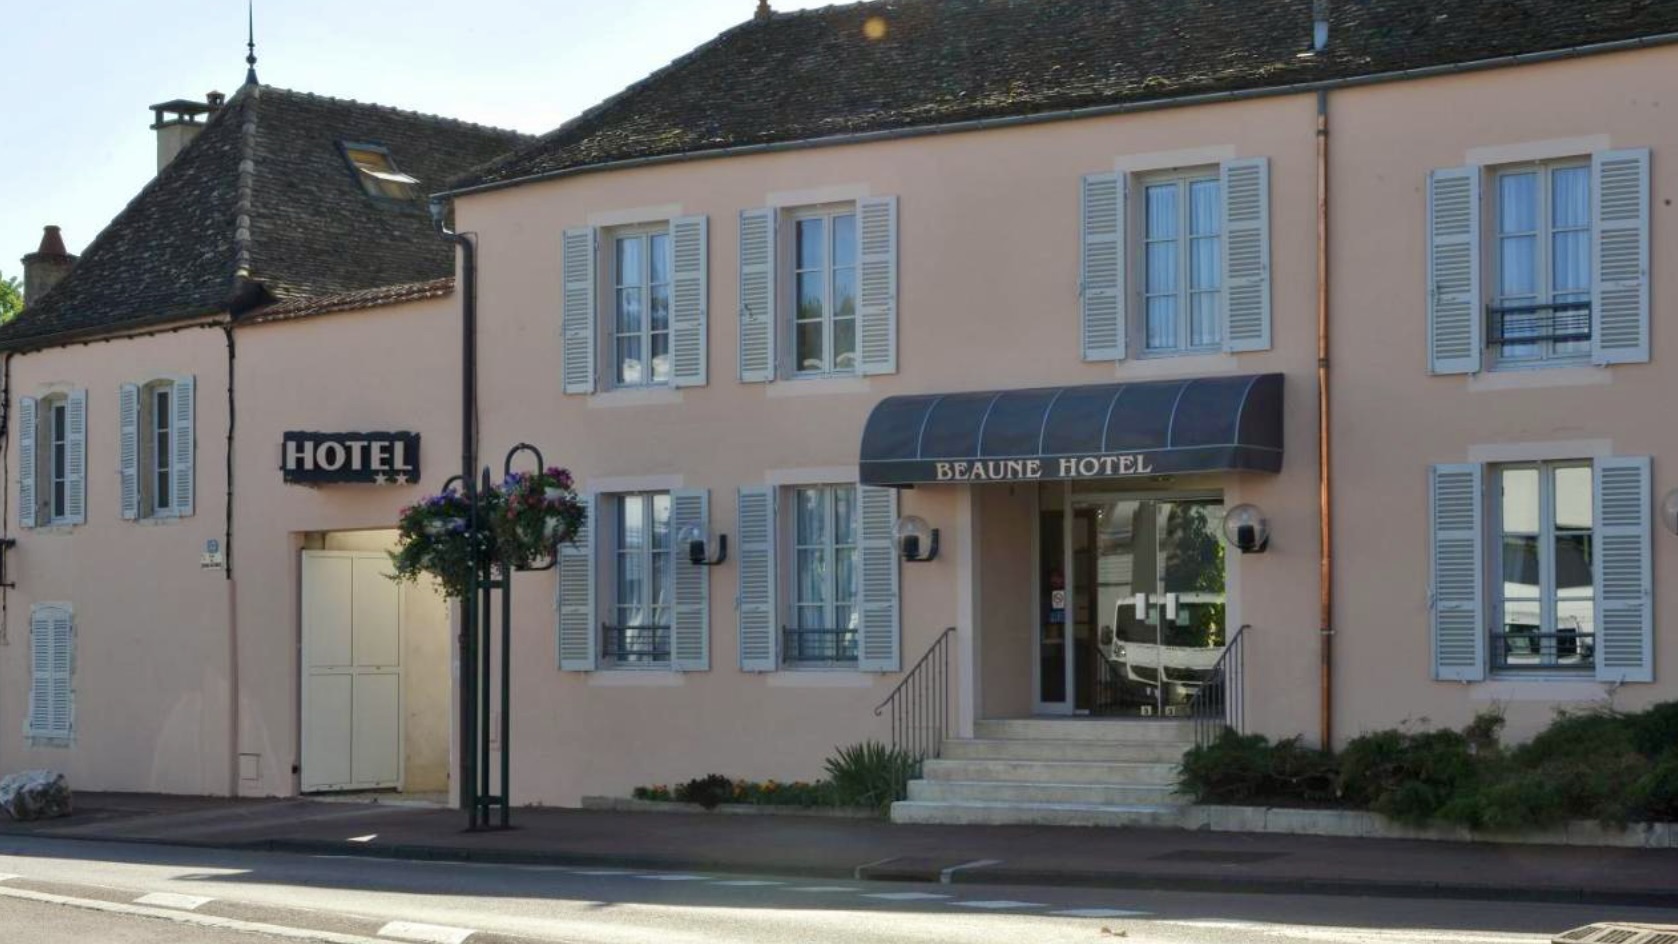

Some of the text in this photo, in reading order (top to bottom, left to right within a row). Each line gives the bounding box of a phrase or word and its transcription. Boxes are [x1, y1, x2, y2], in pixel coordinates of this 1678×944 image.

[286, 441, 413, 471] HOTEL
[935, 455, 1153, 481] BEAUNE HOTEL
